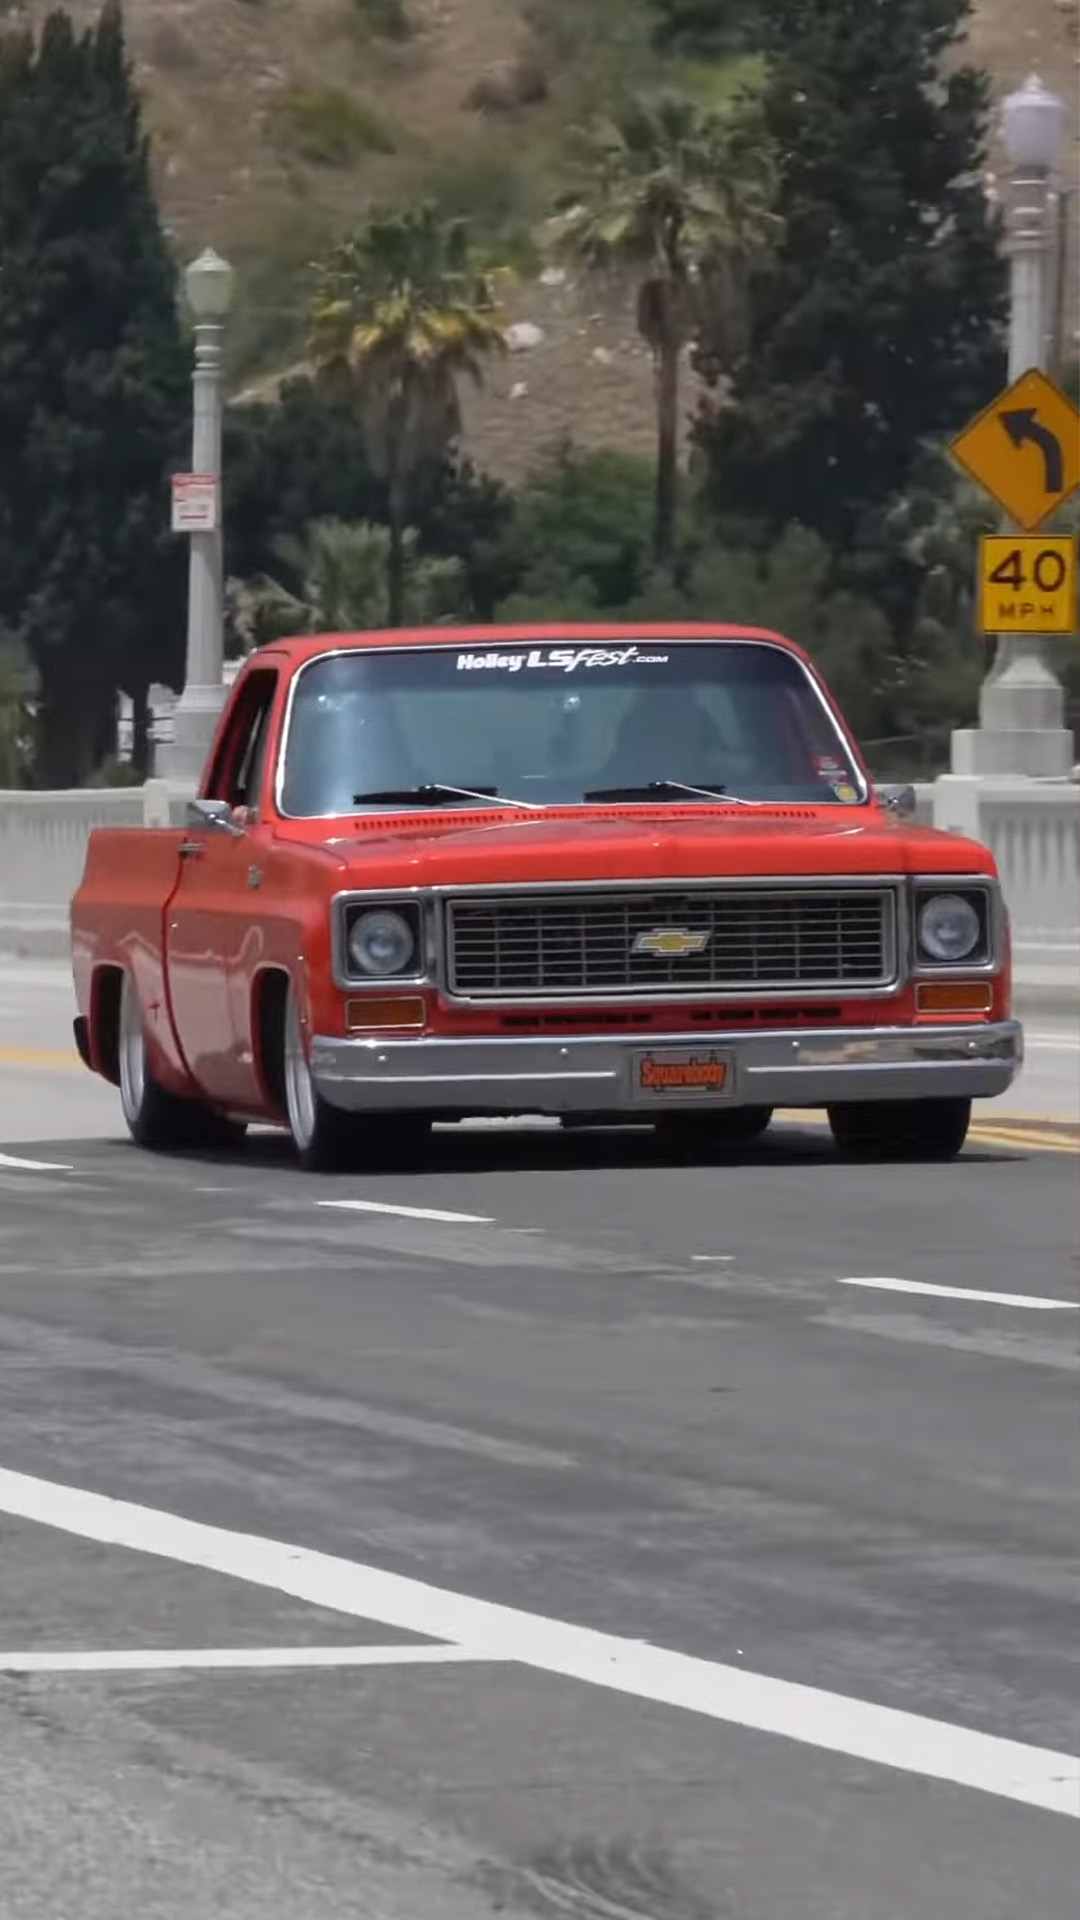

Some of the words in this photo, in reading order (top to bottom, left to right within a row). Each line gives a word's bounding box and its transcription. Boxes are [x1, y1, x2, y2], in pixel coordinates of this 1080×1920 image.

[988, 549, 1066, 592] 40
[998, 602, 1055, 618] MPH
[456, 653, 523, 672] Holley
